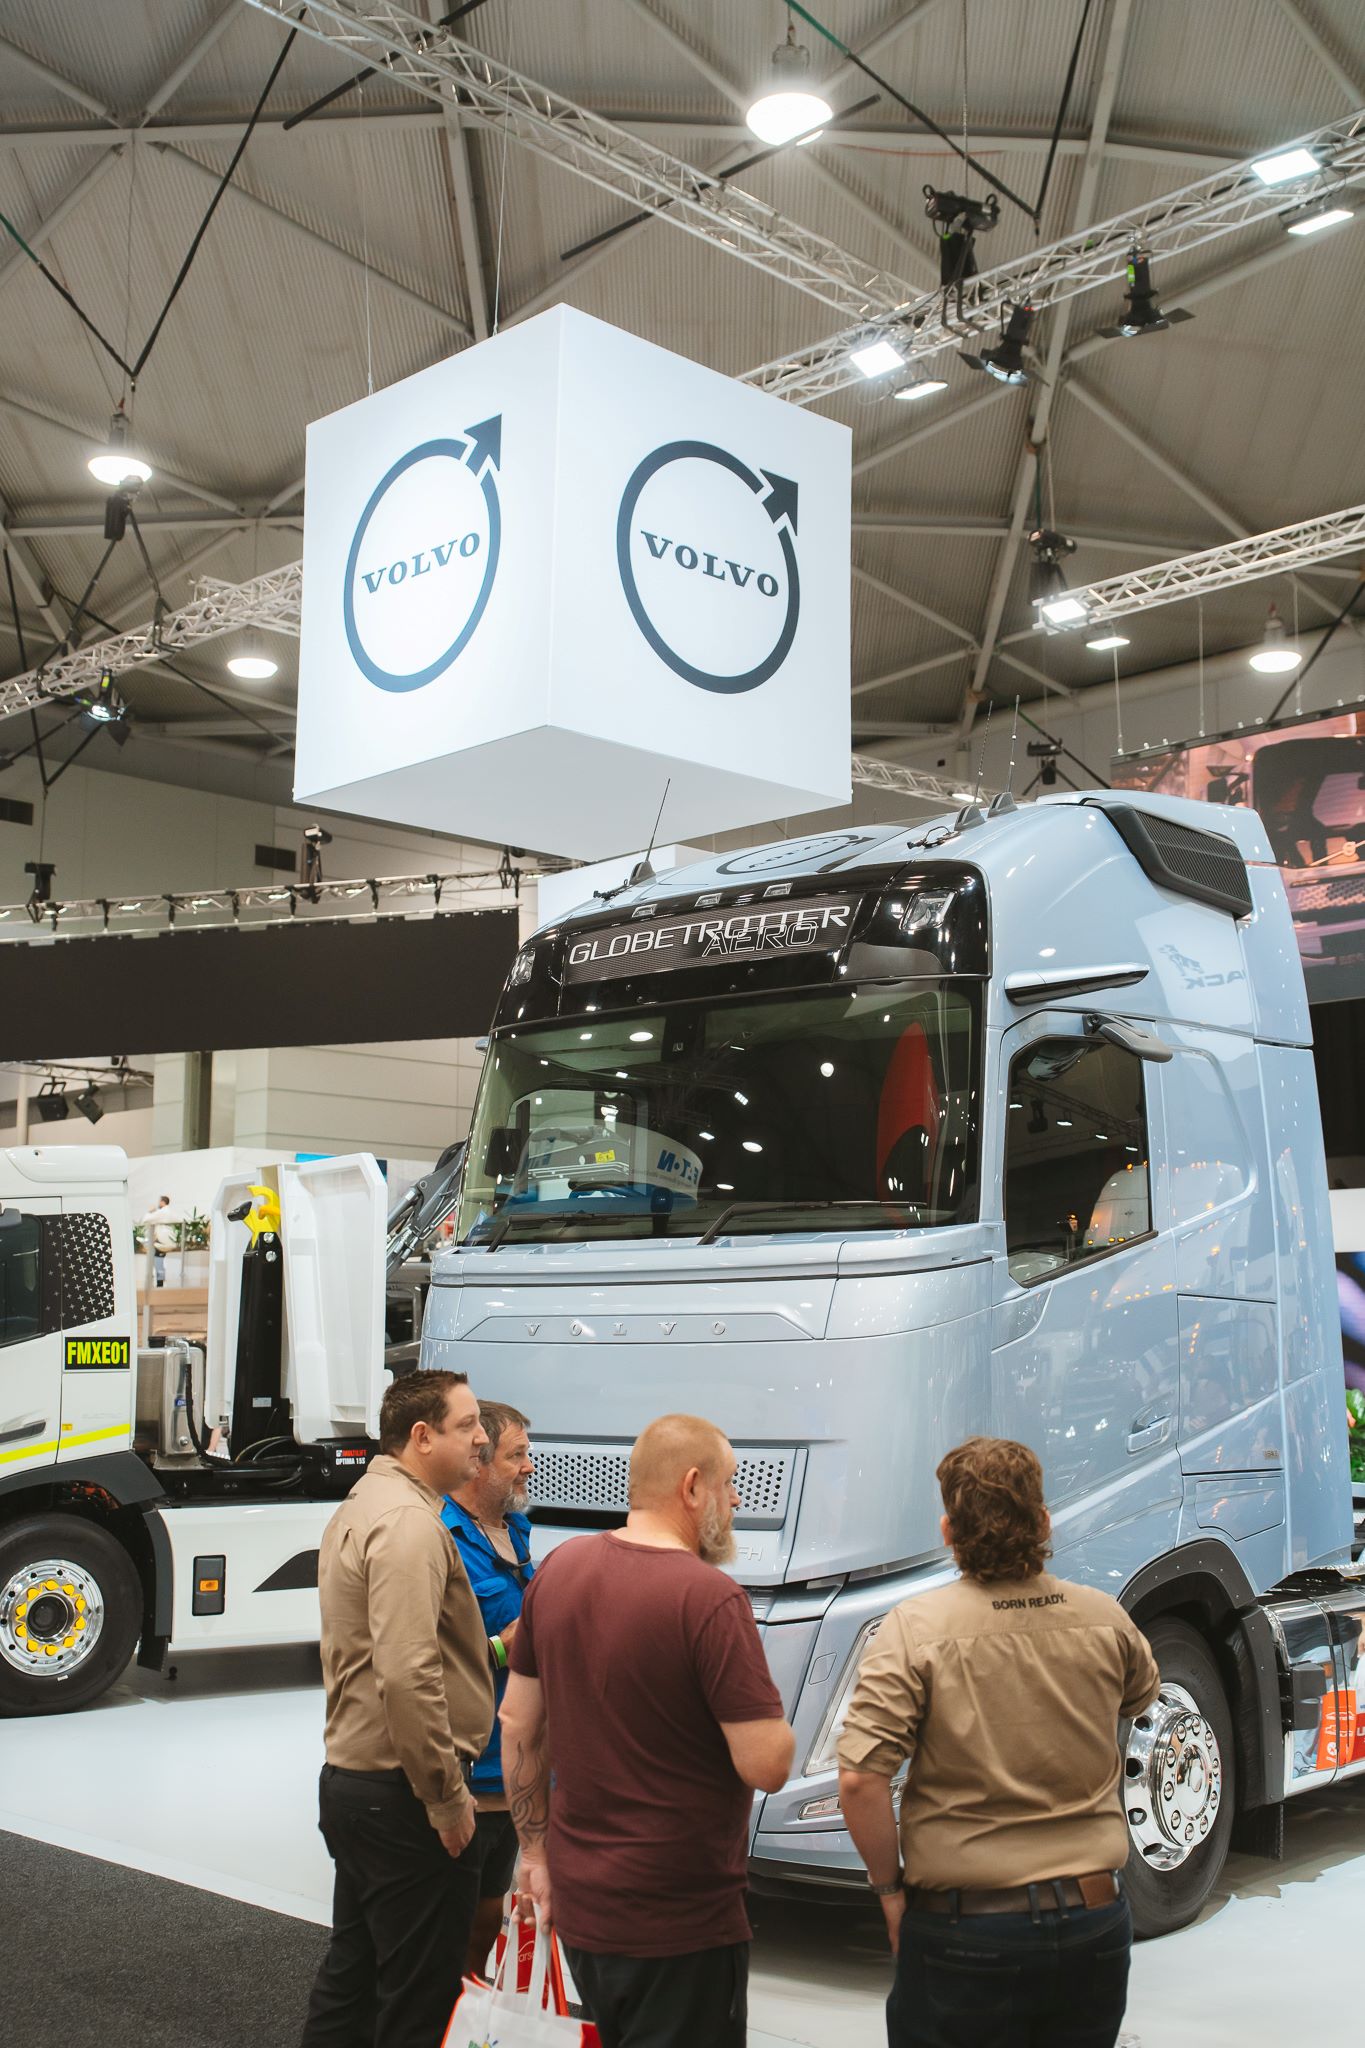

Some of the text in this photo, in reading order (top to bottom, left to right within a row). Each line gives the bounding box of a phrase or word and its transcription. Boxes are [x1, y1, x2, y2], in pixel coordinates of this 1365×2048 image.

[361, 532, 480, 594] VOLVO
[641, 530, 779, 597] VOLVO
[702, 920, 819, 957] AERO
[525, 1320, 726, 1337] VOLVO
[67, 1341, 128, 1365] FMXE01
[336, 1457, 355, 1465] OPTIMA
[992, 1593, 1067, 1610] BORN READY.
